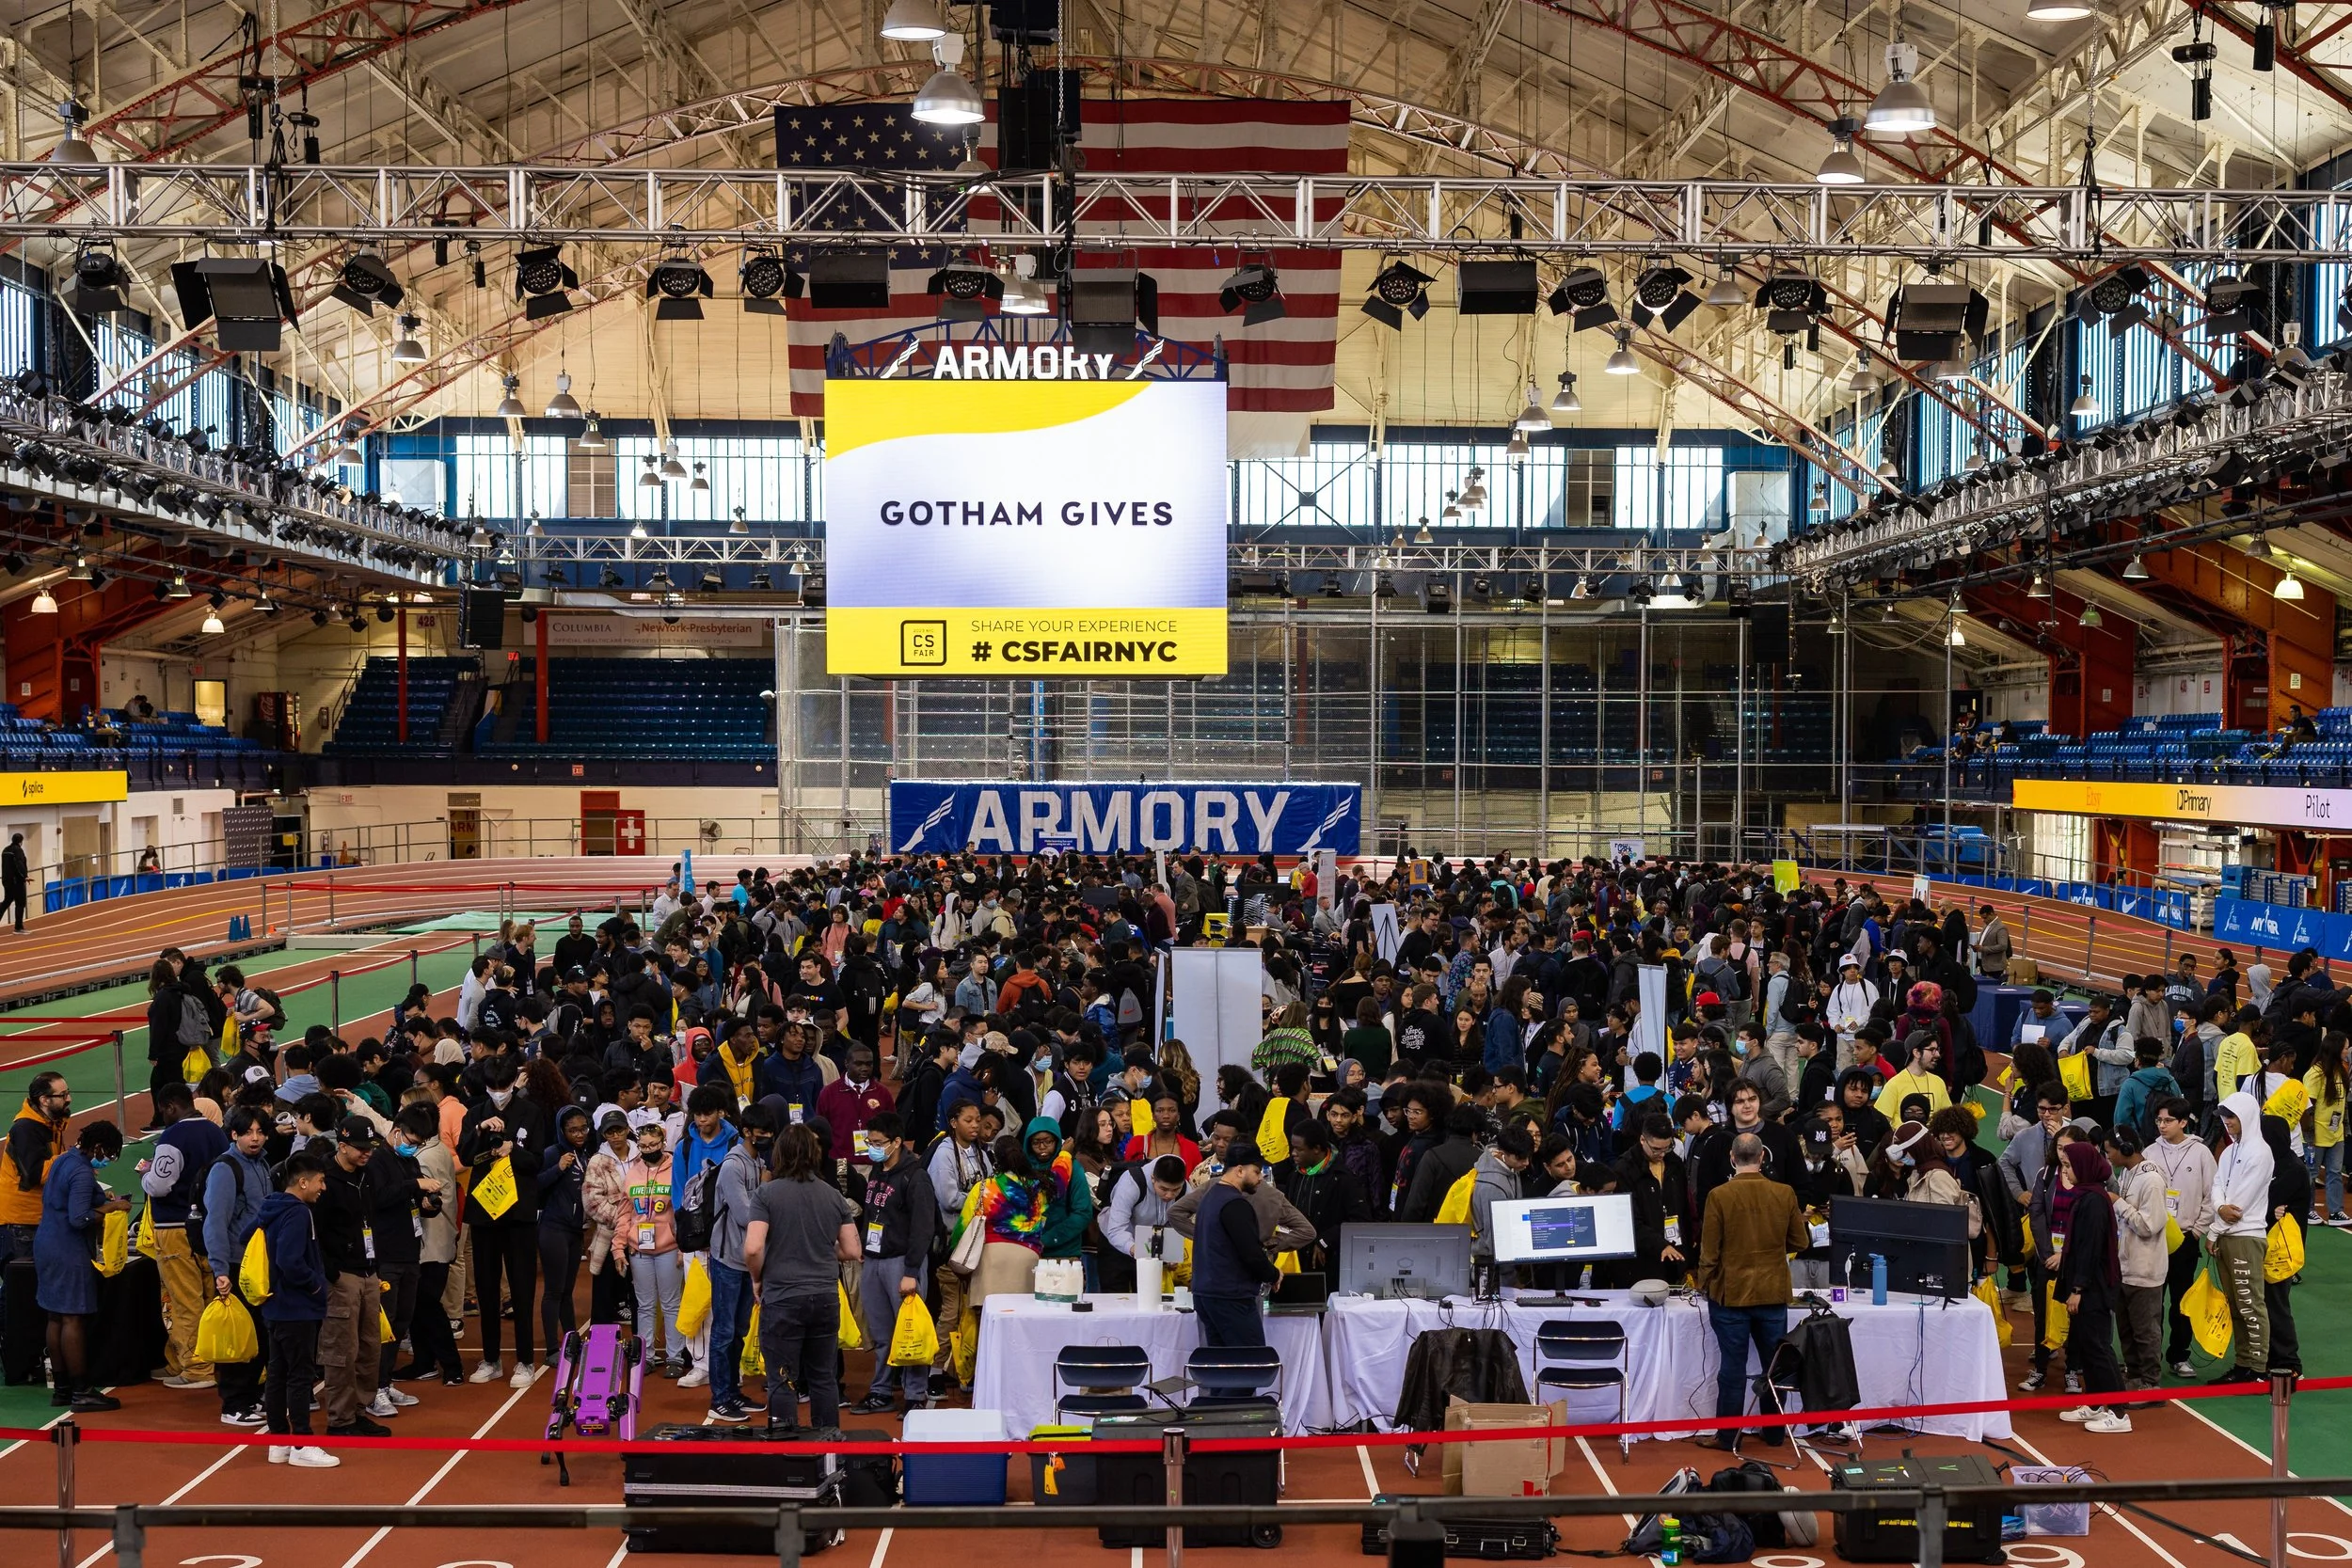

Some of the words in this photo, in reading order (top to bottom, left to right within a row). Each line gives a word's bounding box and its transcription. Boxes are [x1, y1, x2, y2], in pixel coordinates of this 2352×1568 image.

[933, 345, 1113, 380] ARMORY
[881, 500, 1042, 526] GOTHAM
[1061, 500, 1173, 526] GIVES
[418, 615, 436, 627] 428
[642, 623, 752, 635] NewYork-Presbyterian
[971, 620, 1024, 632] SHARE
[1029, 620, 1073, 632] YOUR
[1079, 620, 1177, 632] EXPERIENCE
[914, 635, 934, 648] CS
[971, 641, 993, 662] #
[1001, 641, 1178, 662] CSFAIRNYC
[28, 781, 43, 798] splice
[2086, 786, 2101, 810] Etsy
[2305, 794, 2330, 819] Pilot
[966, 790, 1291, 852] ARMORY
[1070, 1099, 1076, 1112] 3
[632, 1186, 644, 1195] LIVE
[657, 1185, 671, 1194] NEW
